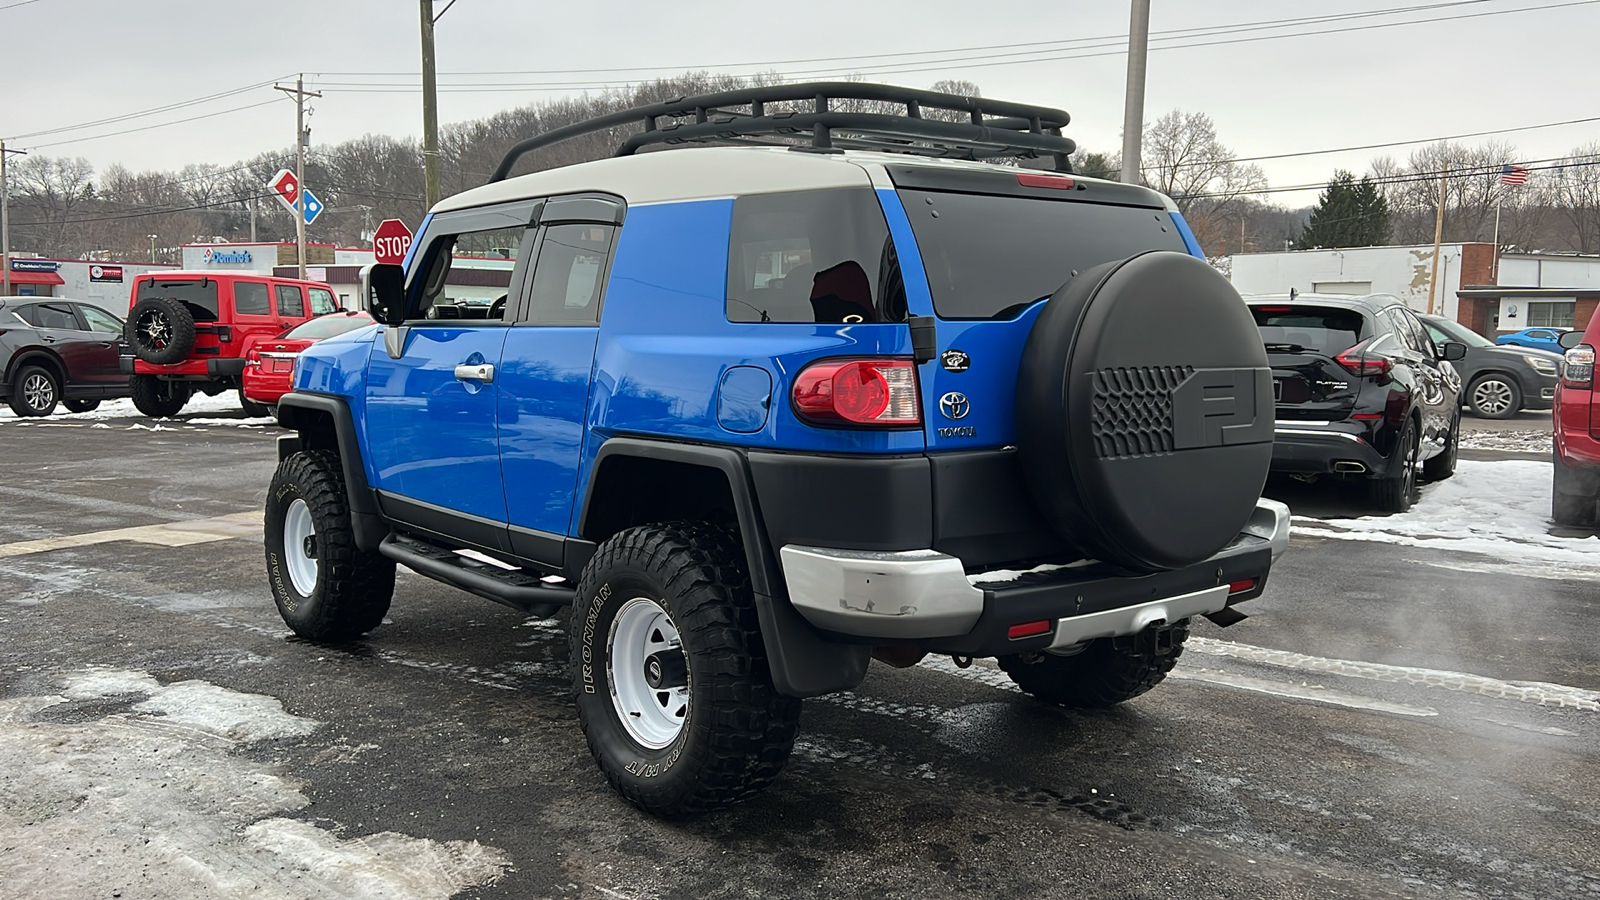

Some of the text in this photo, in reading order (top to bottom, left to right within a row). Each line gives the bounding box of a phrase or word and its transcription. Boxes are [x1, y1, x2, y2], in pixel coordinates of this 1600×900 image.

[376, 235, 411, 258] STOP
[212, 250, 252, 263] Domino's
[937, 426, 977, 439] TOYOTA
[582, 583, 612, 694] IRONMAN
[624, 760, 660, 777] M/T
